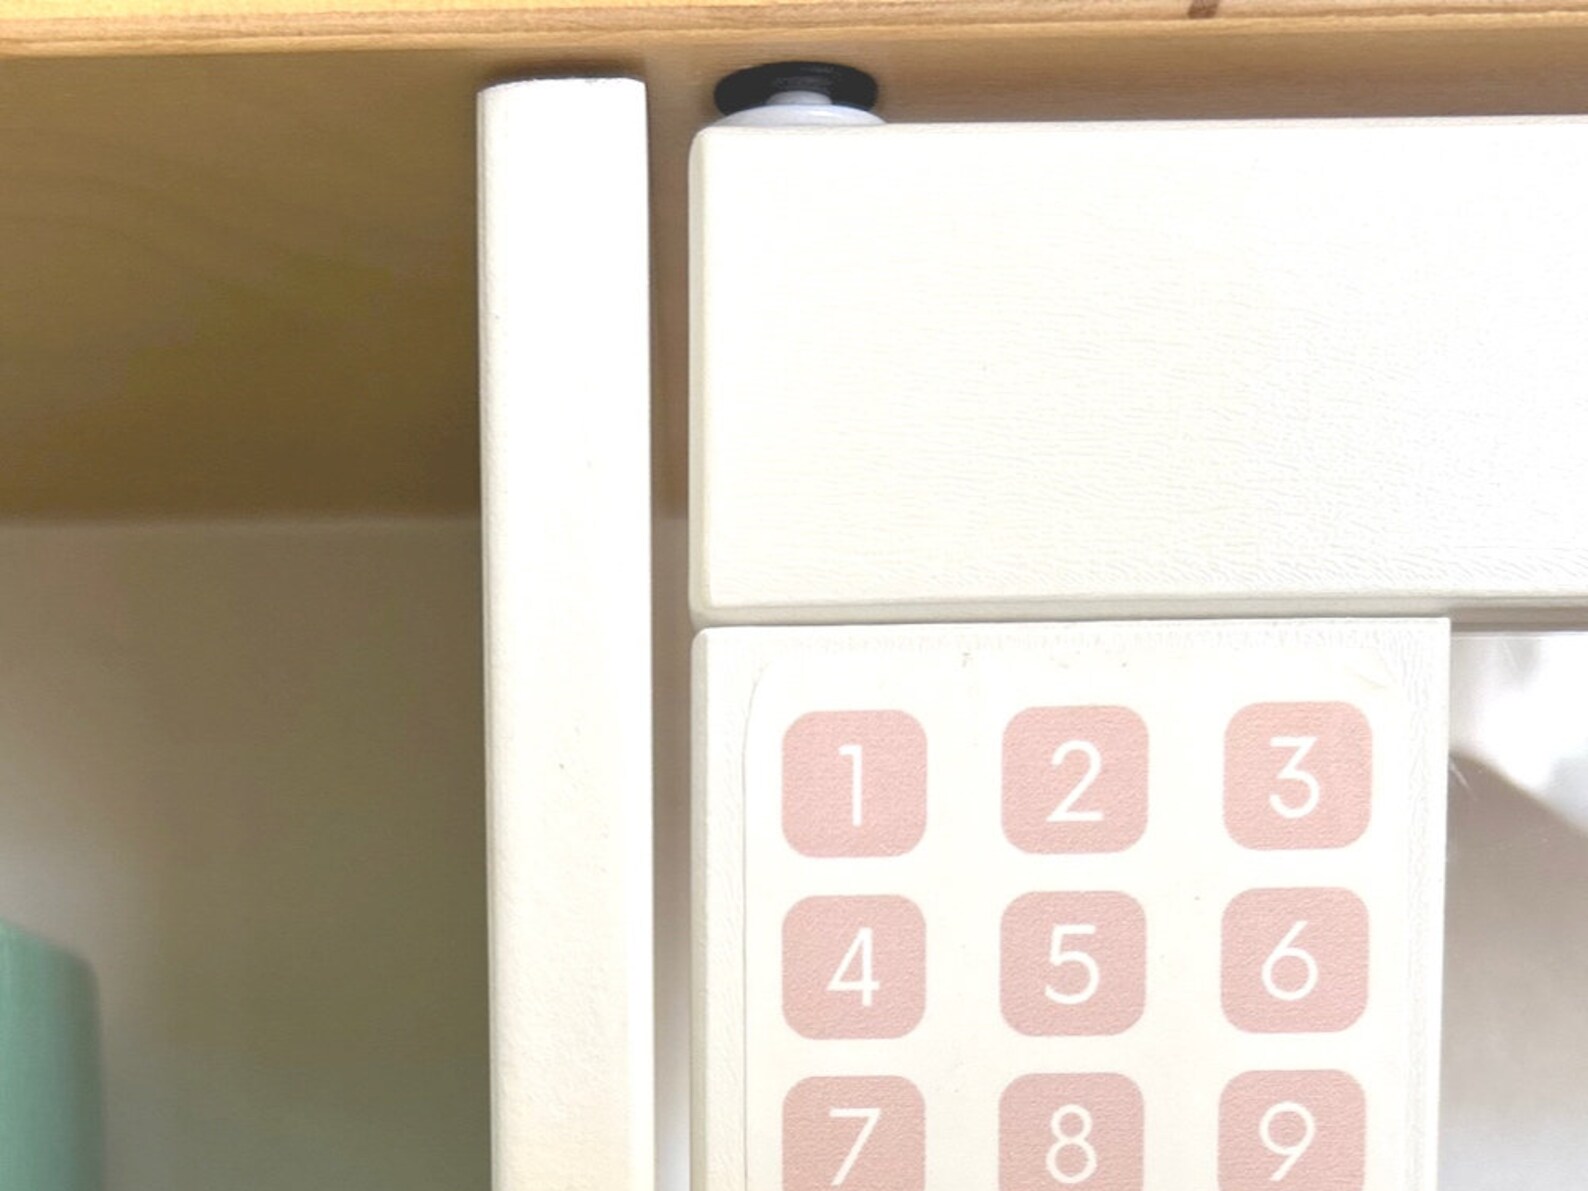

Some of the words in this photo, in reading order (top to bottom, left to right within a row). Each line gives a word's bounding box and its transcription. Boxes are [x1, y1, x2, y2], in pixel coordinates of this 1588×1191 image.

[837, 744, 864, 827] 1
[1046, 739, 1104, 823] 2
[1268, 735, 1321, 820] 3
[827, 926, 881, 1007] 4
[1043, 923, 1101, 1006] 5
[1260, 920, 1319, 1002] 6
[829, 1106, 882, 1187] 7
[1045, 1103, 1098, 1185] 8
[1258, 1100, 1316, 1183] 9
